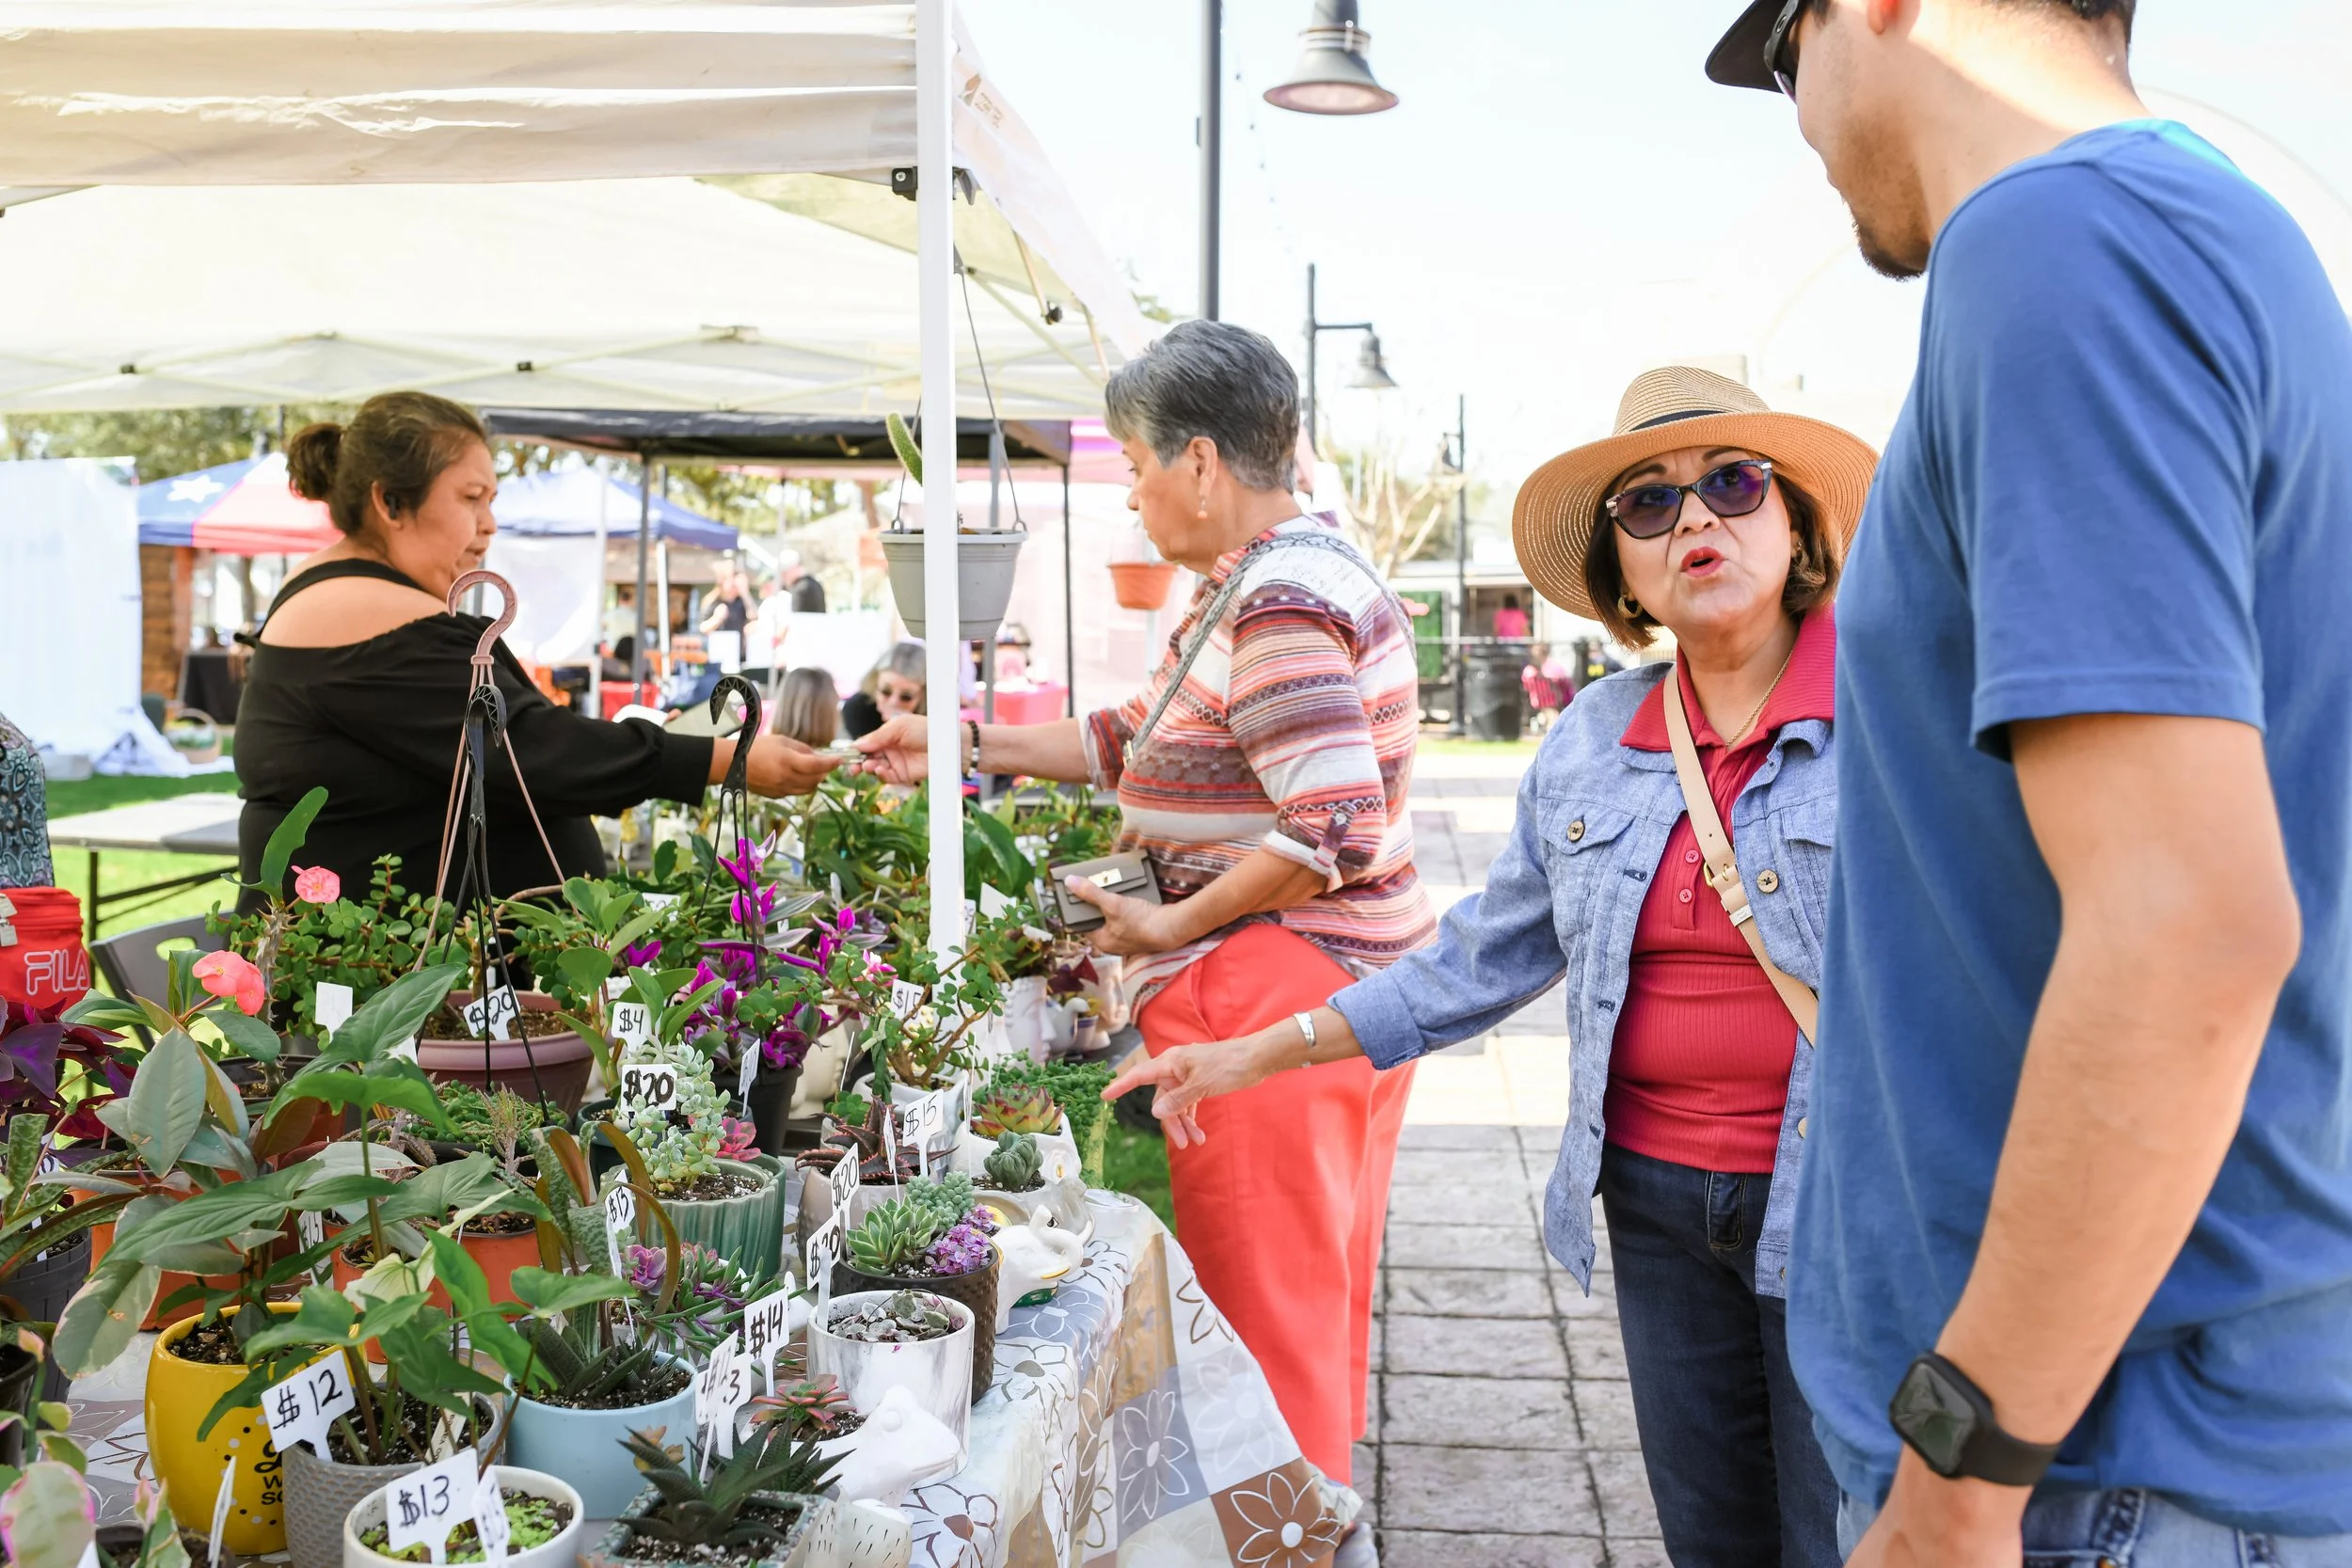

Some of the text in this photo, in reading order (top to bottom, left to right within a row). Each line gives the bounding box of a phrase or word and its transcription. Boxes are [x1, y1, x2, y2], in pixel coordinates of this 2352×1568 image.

[24, 948, 91, 996] FILA
[469, 991, 514, 1033] $20
[619, 1008, 644, 1035] $4
[623, 1068, 675, 1107] $20
[905, 1094, 937, 1137] $15
[833, 1155, 858, 1210] $20
[749, 1299, 783, 1359] $14
[272, 1369, 342, 1430] $12
[397, 1475, 450, 1528] $13
